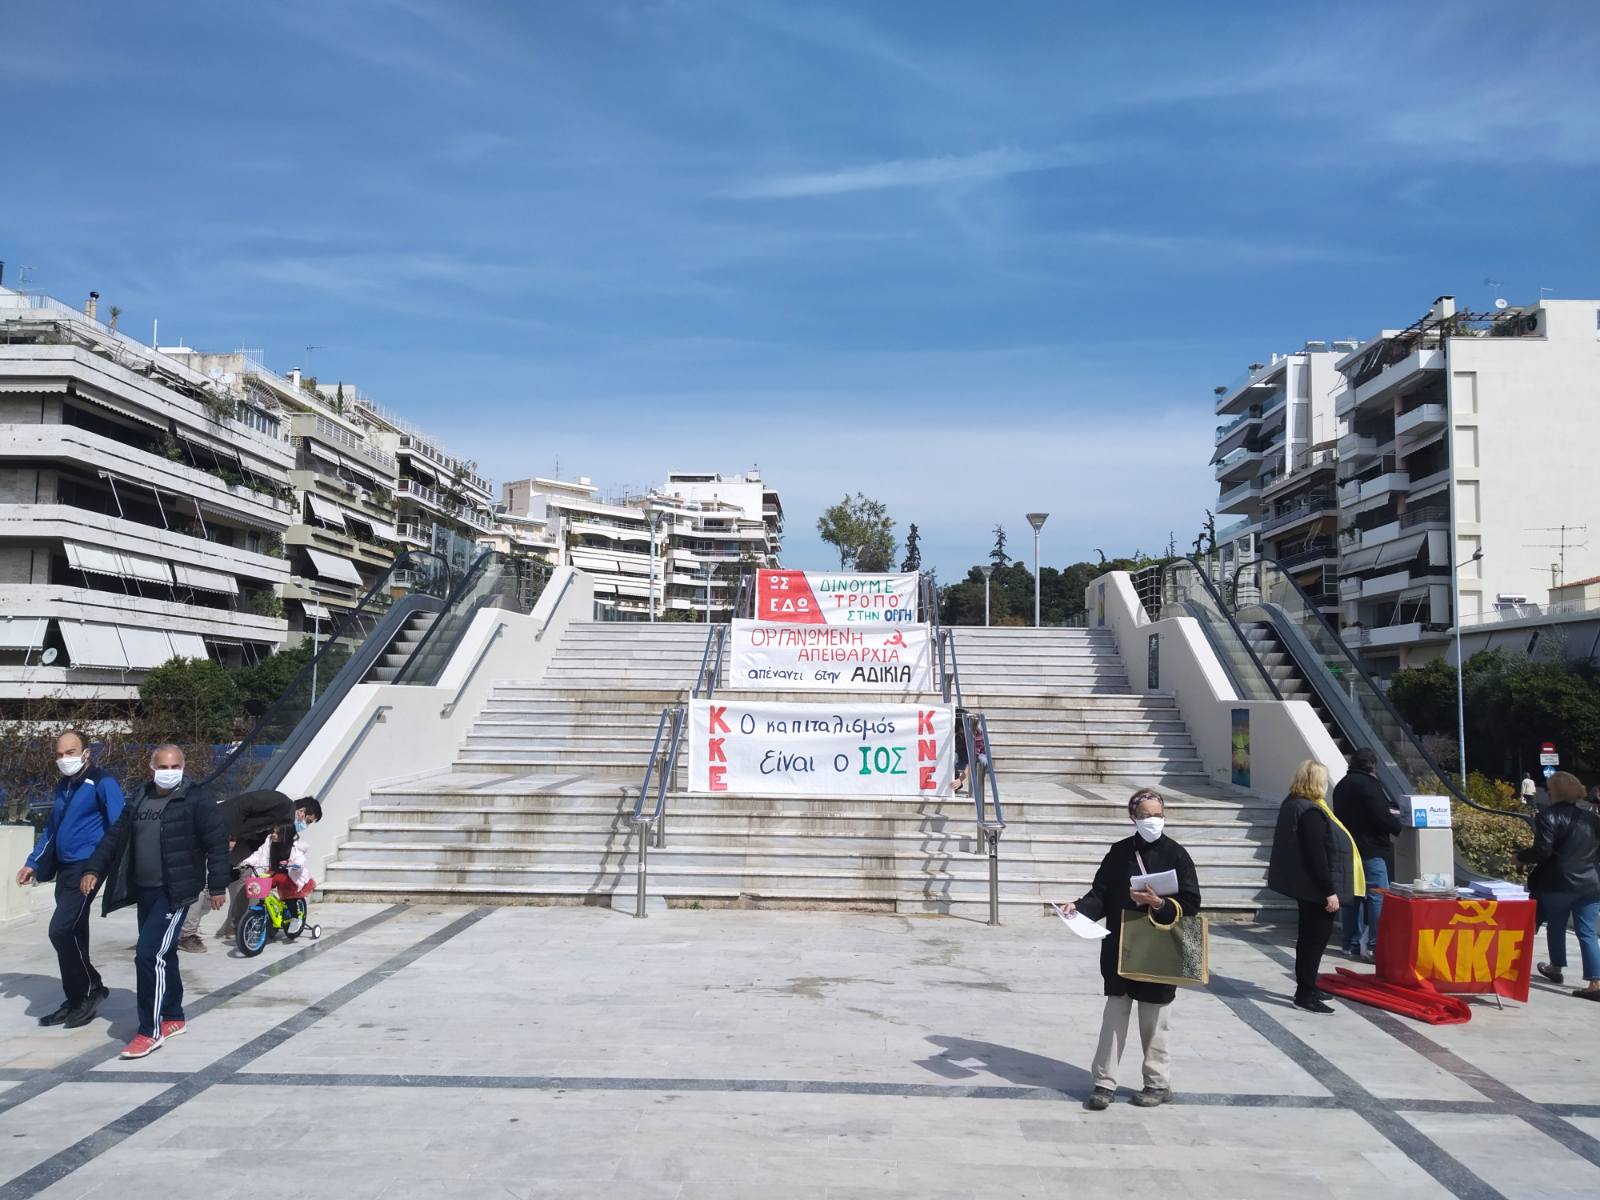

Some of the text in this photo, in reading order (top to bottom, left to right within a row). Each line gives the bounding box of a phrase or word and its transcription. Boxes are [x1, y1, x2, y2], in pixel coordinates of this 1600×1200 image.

[820, 579, 894, 594] ΔΙΝΟΥΜΕ
[770, 598, 809, 612] ΕΔΩ
[847, 609, 912, 622] ΣΤΗΝ ΟΡΓΗ
[751, 628, 863, 646] ΟΡΓΑΝΩΜΕΝΗ
[797, 648, 900, 663] ΑΠΕΙΘΑΡΧΙΑ
[748, 665, 911, 684] απέναντι στην ΑΔΙΚΙΑ
[740, 713, 896, 740] Ο καπιταλισμός
[708, 705, 732, 791] ΚΚΕ
[918, 710, 937, 790] ΚΝΕ
[858, 746, 908, 775] ΙΟΣ
[1414, 929, 1524, 982] ΚΚΕ
